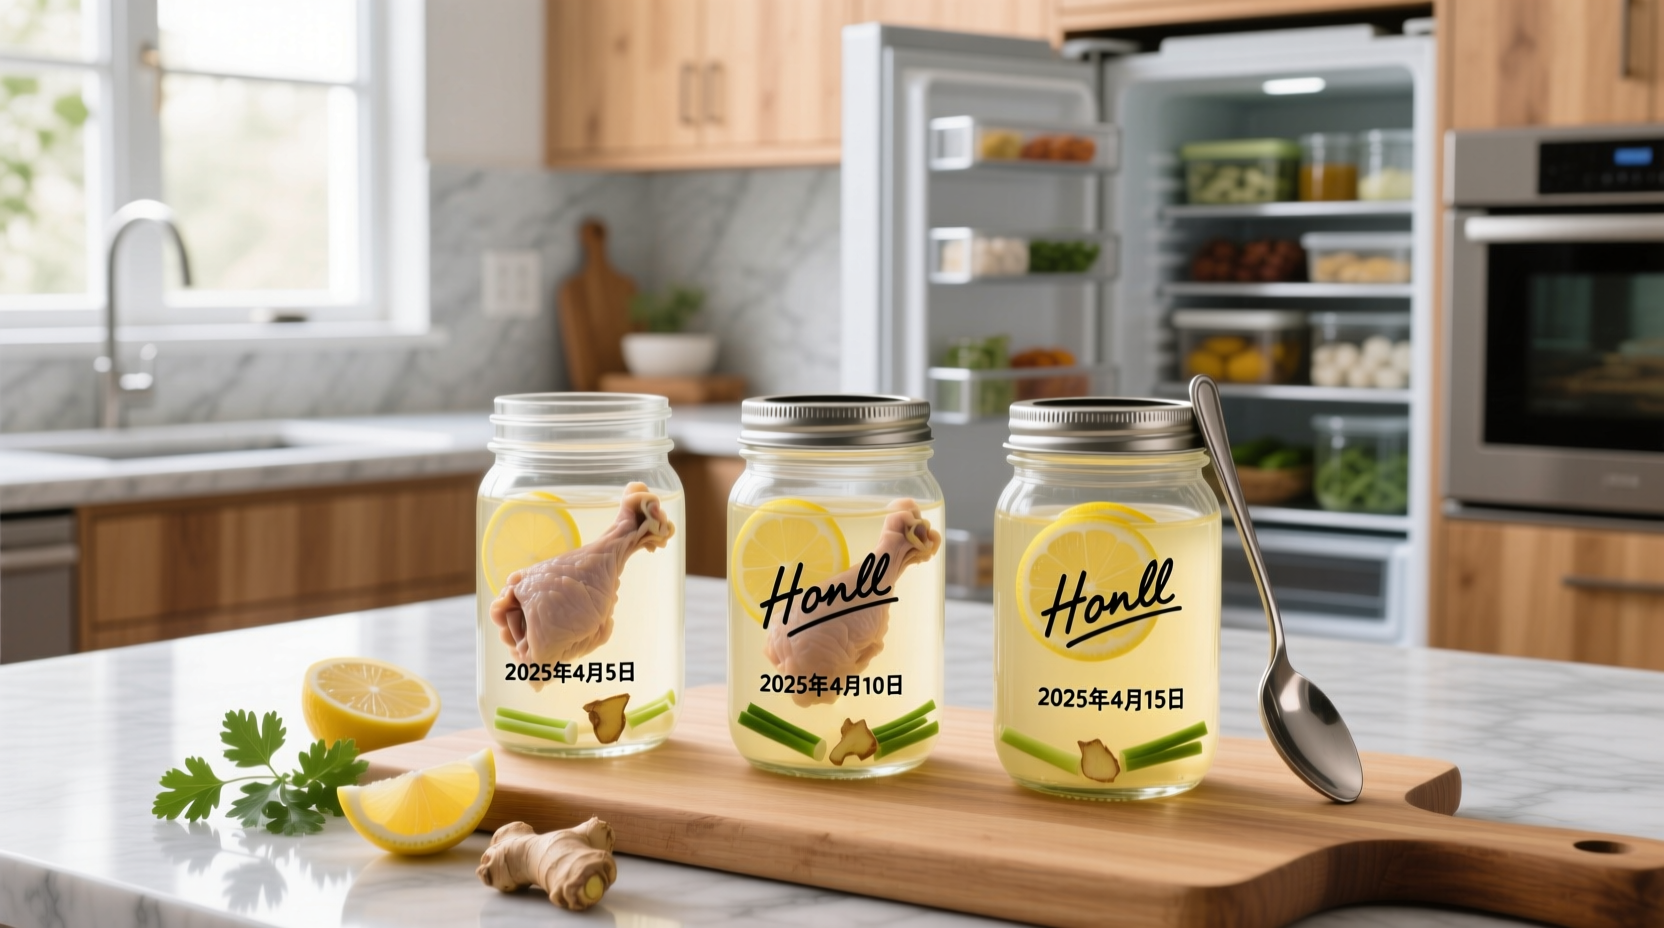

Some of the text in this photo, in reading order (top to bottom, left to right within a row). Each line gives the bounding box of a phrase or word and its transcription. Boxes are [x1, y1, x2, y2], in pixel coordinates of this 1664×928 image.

[760, 551, 893, 631] Honll
[1040, 556, 1176, 639] Honll
[504, 660, 636, 684] 2025年4月5日
[759, 672, 904, 698] 2025年4月10日
[1037, 686, 1185, 712] 2025年4月15日
